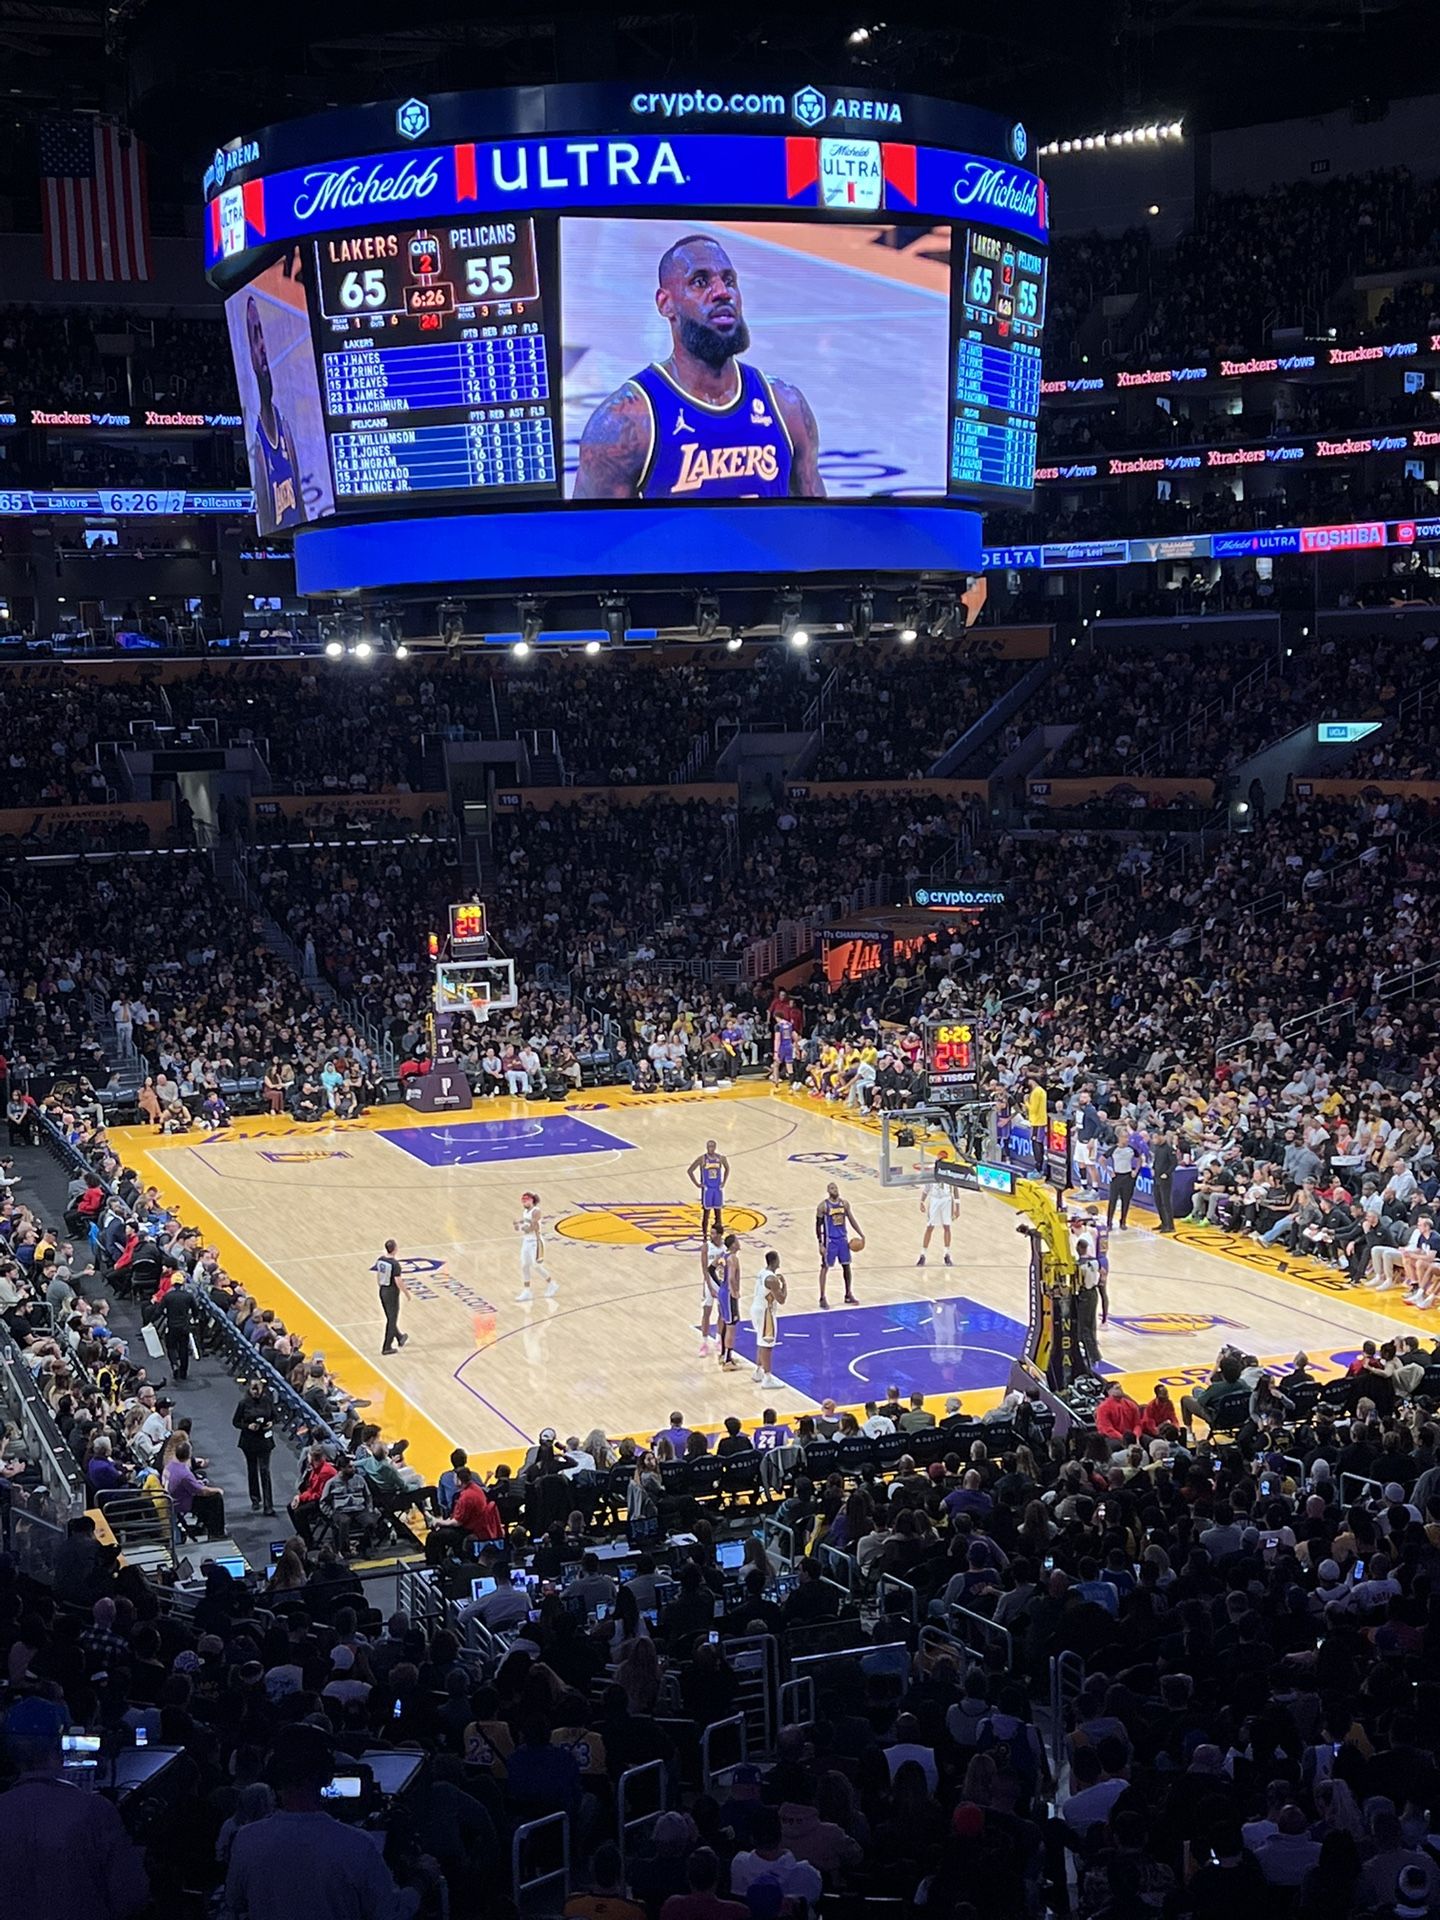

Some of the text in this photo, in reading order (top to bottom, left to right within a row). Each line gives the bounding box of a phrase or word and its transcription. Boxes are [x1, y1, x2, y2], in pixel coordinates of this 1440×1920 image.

[632, 90, 902, 123] crypto.com ARENA
[226, 141, 260, 172] ARENA
[823, 158, 880, 177] ULTRA
[294, 141, 685, 219] Michelob ULTRA
[953, 162, 1038, 217] Michelob
[450, 223, 516, 249] PELICANS
[329, 235, 399, 263] LAKERS
[410, 240, 437, 254] QTR
[973, 232, 1001, 261] LAKERS
[418, 255, 432, 272] 2
[466, 256, 514, 295] 55
[1004, 267, 1011, 282] 2
[340, 269, 386, 308] 65
[973, 266, 992, 303] 65
[410, 290, 446, 308] 6:26
[1019, 280, 1038, 317] 55
[481, 305, 489, 317] 3
[517, 303, 525, 313] 5
[390, 314, 398, 325] 6
[421, 314, 438, 329] 24
[502, 324, 518, 336] AST
[328, 355, 339, 365] 11
[343, 353, 380, 366] J.HAYES
[1329, 346, 1383, 364] Xtrackers
[328, 368, 340, 377] 12
[344, 364, 385, 377] T.PRINCE
[1221, 358, 1278, 376] Xtrackers
[330, 380, 341, 390] 15
[1117, 370, 1171, 387] Xtrackers
[331, 392, 342, 401] 23
[345, 389, 385, 401] L.JAMES
[467, 380, 480, 391] 12
[332, 404, 343, 414] 28
[347, 398, 410, 413] R.HACHIMURA
[468, 392, 481, 403] 14
[31, 410, 92, 425] Xtrackers
[145, 411, 204, 425] Xtrackers
[510, 407, 524, 418] AST
[339, 437, 344, 446] 1
[350, 431, 416, 446] Z.WILLIAMSON
[470, 425, 484, 436] 20
[339, 449, 346, 458] 5
[351, 445, 391, 458] H.JONES
[1316, 439, 1371, 456] Xtrackers
[337, 460, 349, 470] 14
[352, 456, 397, 470] B.INGRAM
[473, 449, 486, 460] 16
[1207, 449, 1265, 465] Xtrackers
[338, 472, 350, 482] 15
[353, 467, 409, 482] J.ALVARADO
[671, 442, 779, 493] LAKERS
[1109, 458, 1164, 474] Xtrackers
[340, 484, 351, 494] 22
[354, 480, 393, 494] L.NANCE
[0, 493, 242, 512] 65 Lakers 6:26 2 Pelicans
[1306, 527, 1380, 547] TOSHIBA
[1416, 524, 1440, 536] TOYO
[1259, 535, 1297, 547] ULTRA
[1329, 728, 1346, 736] UCLA
[930, 889, 1005, 904] crypto.com
[457, 918, 479, 934] 24
[835, 931, 879, 939] CHAMPIONS
[938, 1025, 972, 1042] 6:26
[935, 1043, 969, 1071] 24
[942, 1073, 976, 1082] TISSOT
[1220, 1244, 1349, 1291] LEXUS
[758, 1436, 776, 1449] 24
